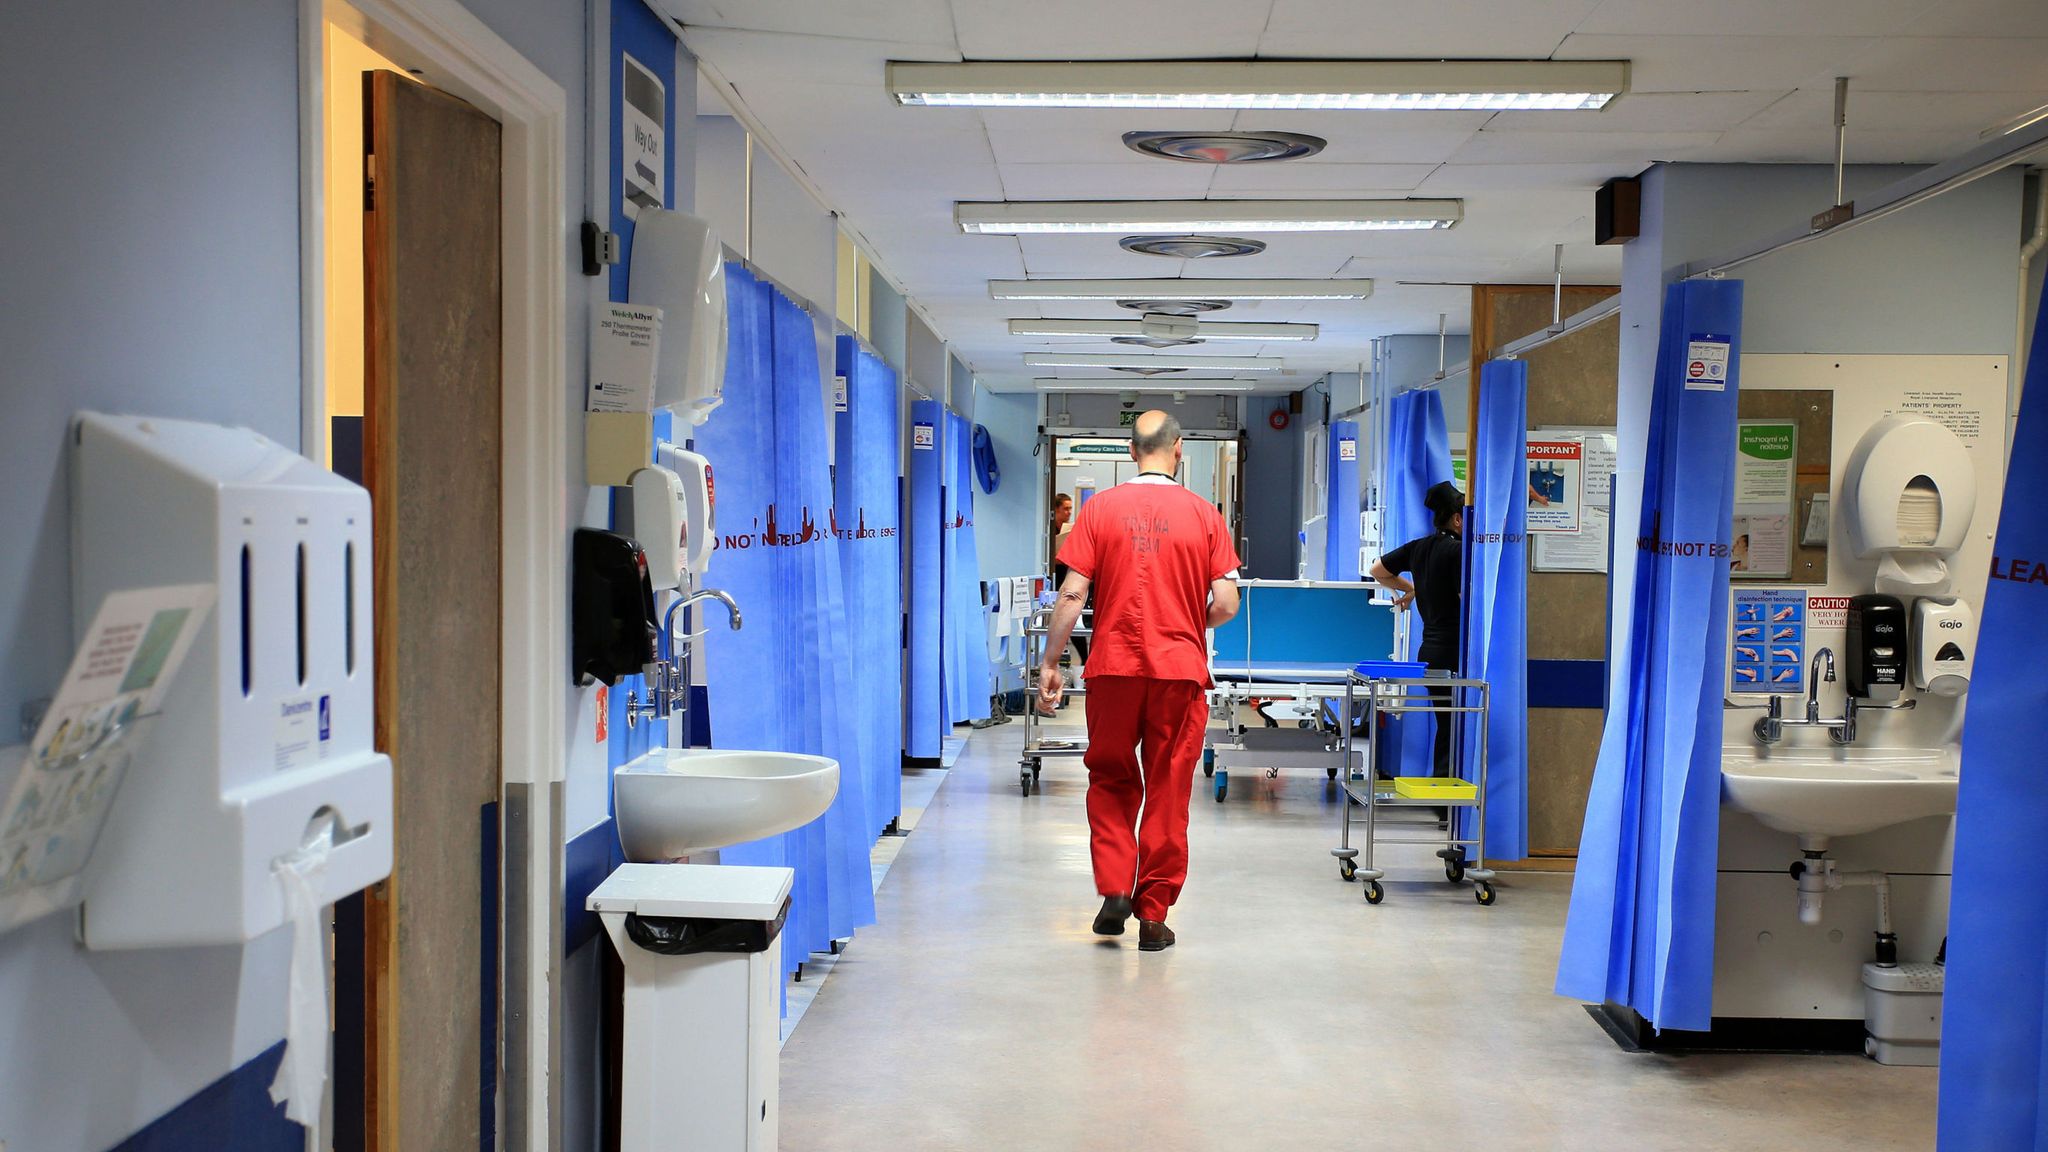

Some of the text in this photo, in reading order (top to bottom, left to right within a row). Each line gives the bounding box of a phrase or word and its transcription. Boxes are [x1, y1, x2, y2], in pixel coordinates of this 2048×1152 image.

[634, 123, 658, 157] Way Out
[601, 320, 652, 333] 250 Thermometer
[612, 329, 651, 340] Probe Covers
[1122, 516, 1168, 535] TRAUMA
[1131, 536, 1159, 553] TEAM
[1674, 542, 1704, 557] NOT
